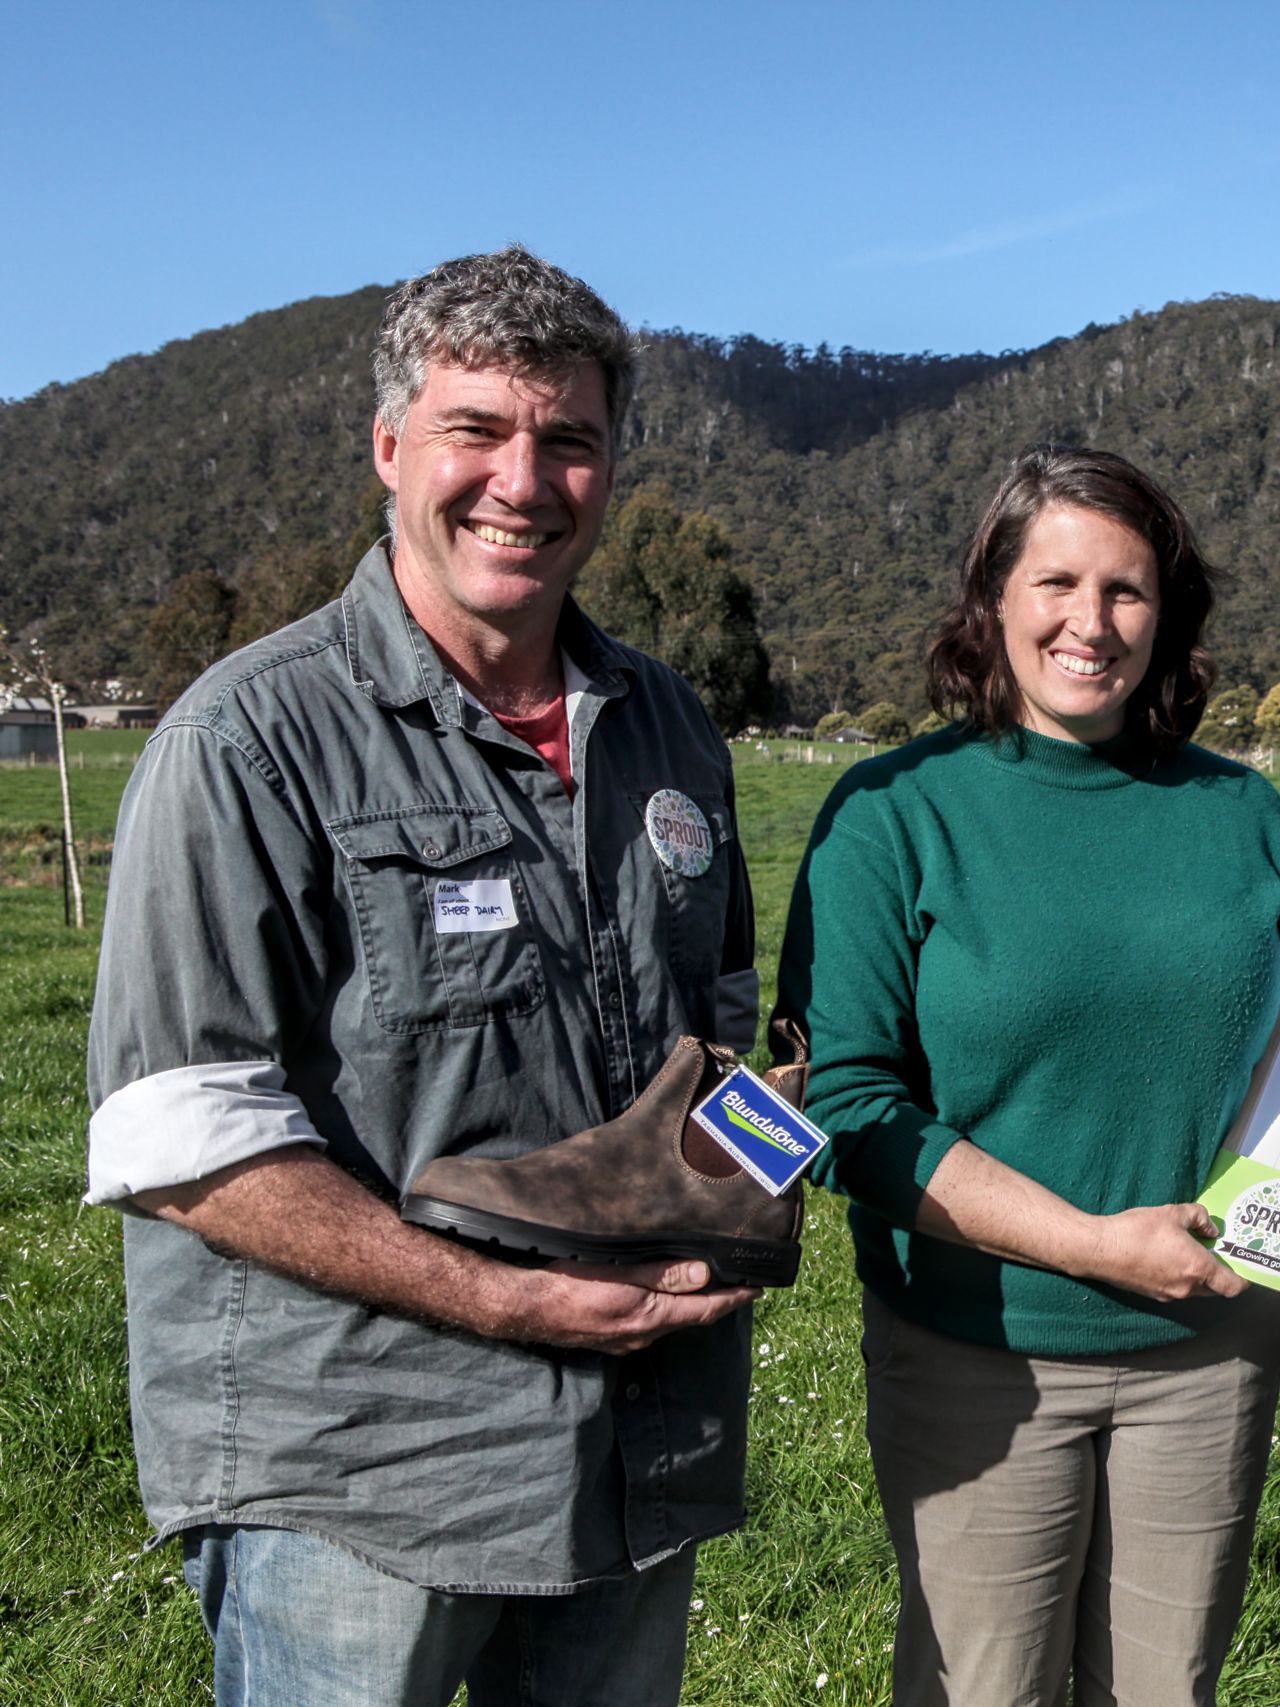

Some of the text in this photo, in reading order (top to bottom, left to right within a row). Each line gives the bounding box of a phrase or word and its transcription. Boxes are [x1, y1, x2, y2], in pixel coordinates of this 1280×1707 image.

[653, 815, 710, 850] SPROUT
[438, 884, 460, 893] Mark
[441, 905, 504, 916] SHEEP DAIRY
[720, 1089, 807, 1156] Blundstone
[1236, 1248, 1270, 1266] Growing
